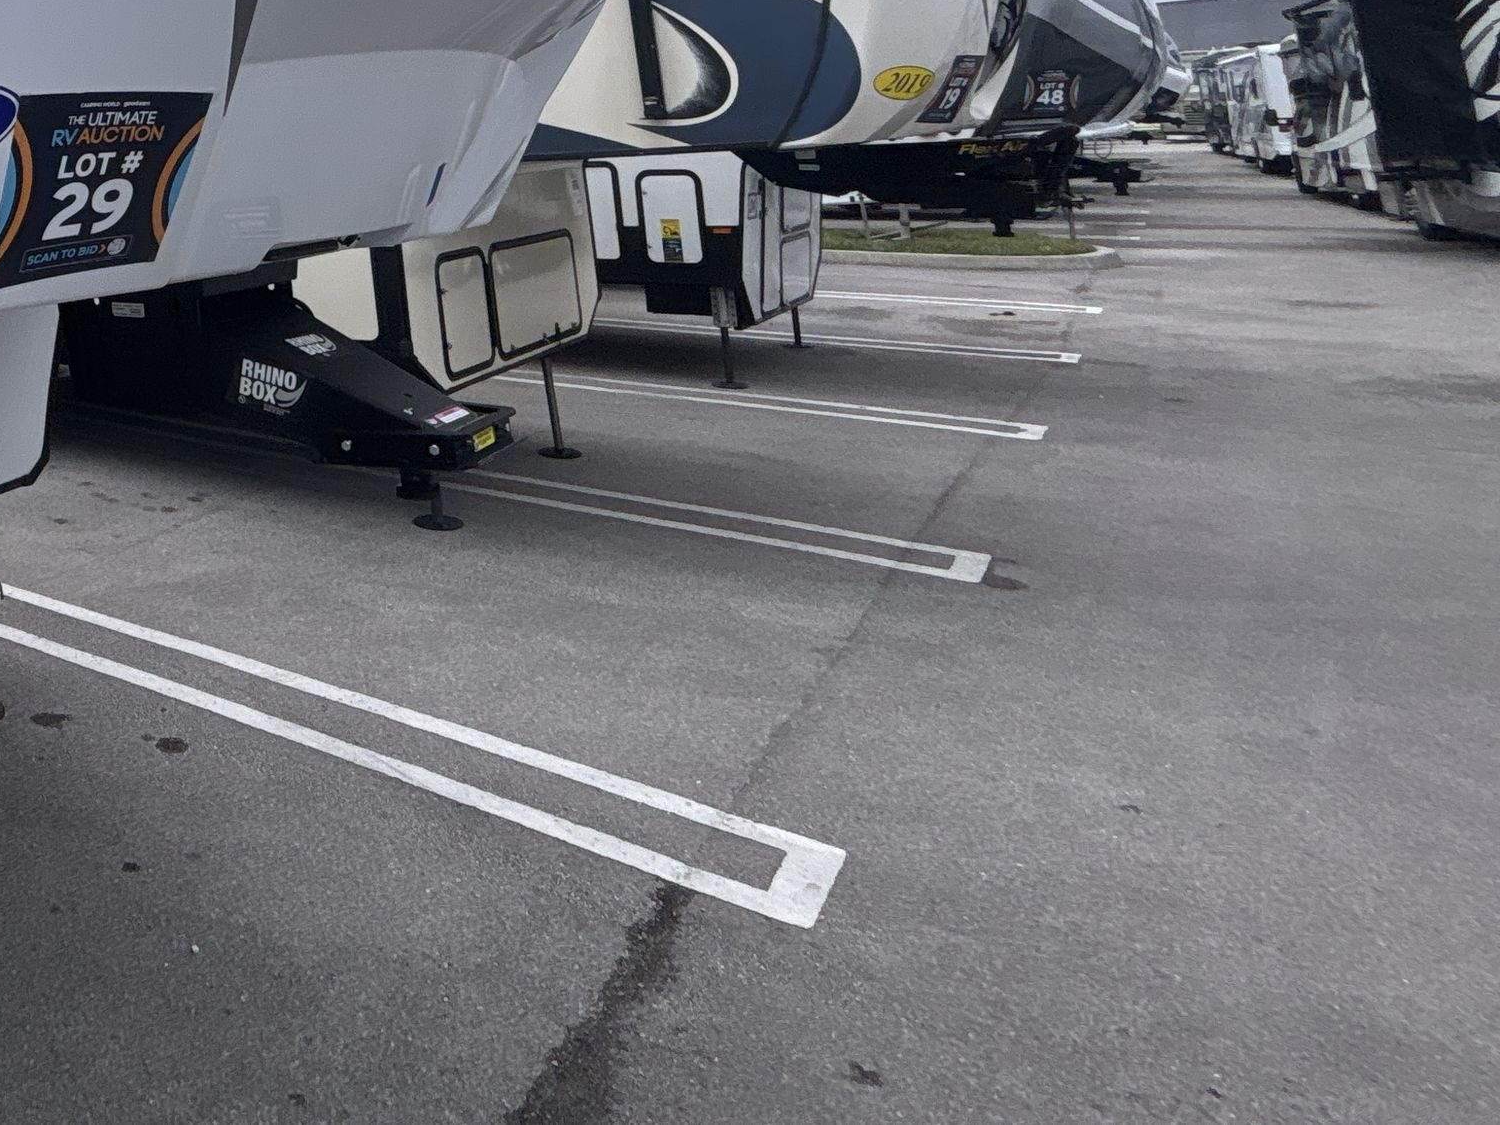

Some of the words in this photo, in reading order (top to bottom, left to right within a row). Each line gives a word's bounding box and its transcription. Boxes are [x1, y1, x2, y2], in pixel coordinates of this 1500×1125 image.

[881, 72, 933, 94] 2019
[938, 88, 961, 109] 19
[1036, 89, 1064, 105] 48
[68, 115, 86, 125] THE
[88, 111, 158, 126] ULTIMATE
[51, 128, 79, 147] RV
[75, 125, 165, 144] AUCTION
[57, 152, 117, 179] LOT
[121, 151, 144, 174] #
[42, 178, 134, 241] 29
[26, 250, 59, 266] SCAN
[61, 247, 77, 260] TO
[77, 243, 99, 257] BID
[241, 358, 297, 391] RHINO
[239, 376, 277, 405] BOX
